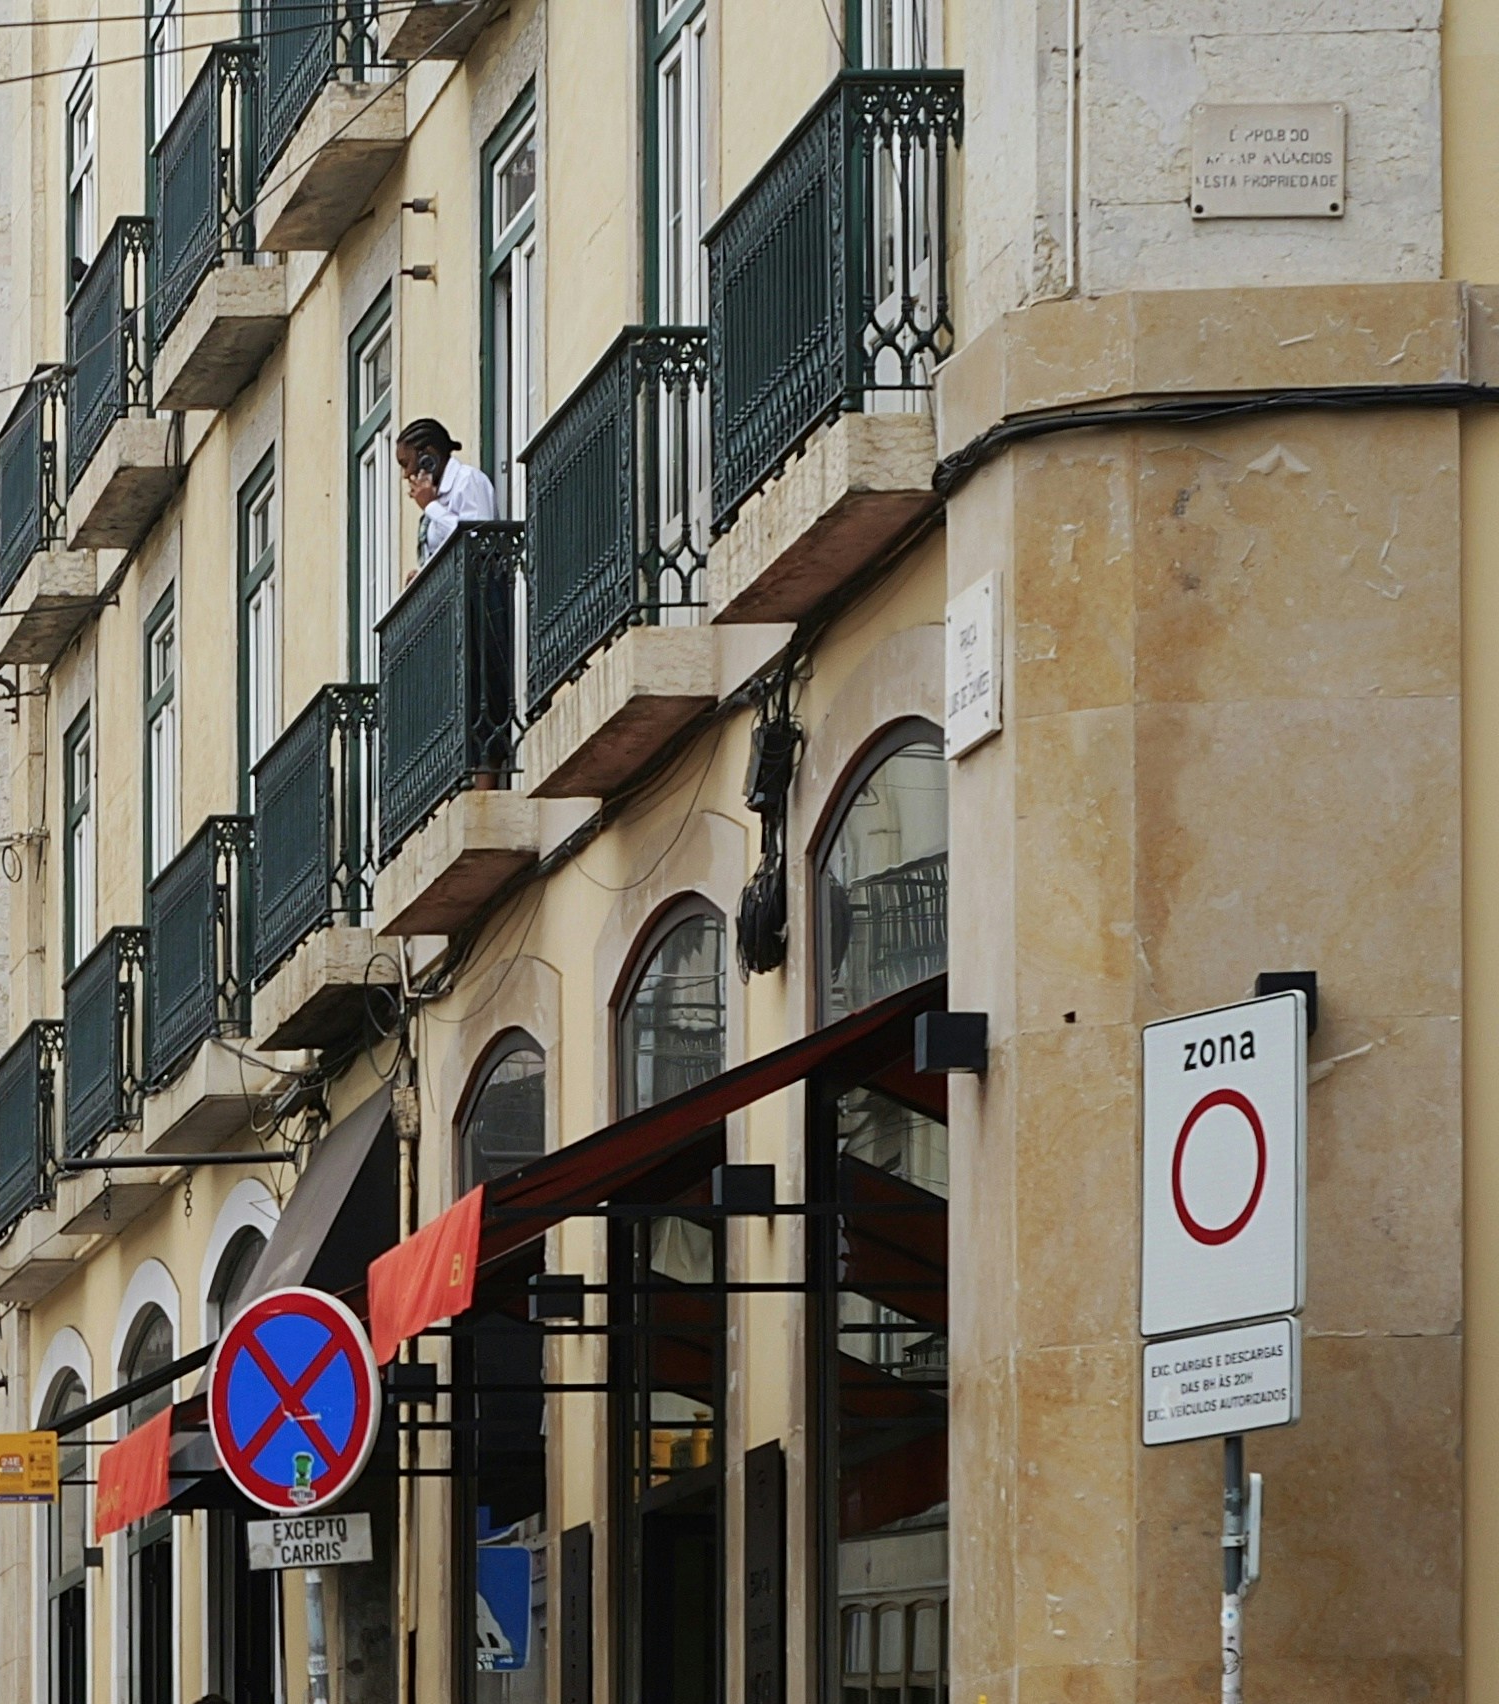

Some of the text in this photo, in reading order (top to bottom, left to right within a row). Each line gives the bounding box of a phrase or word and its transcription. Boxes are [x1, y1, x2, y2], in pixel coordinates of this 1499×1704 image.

[1243, 174, 1340, 188] PROPRIEDADE
[1184, 1030, 1256, 1071] zona
[1174, 1356, 1213, 1375] CARGAS
[1216, 1355, 1222, 1367] E
[1224, 1344, 1284, 1366] DESCARGAS
[1180, 1380, 1200, 1395] DAS
[1220, 1388, 1288, 1410] AUTORIZADOS
[272, 1517, 348, 1541] EXCEPTO
[281, 1541, 342, 1564] CARRIS
